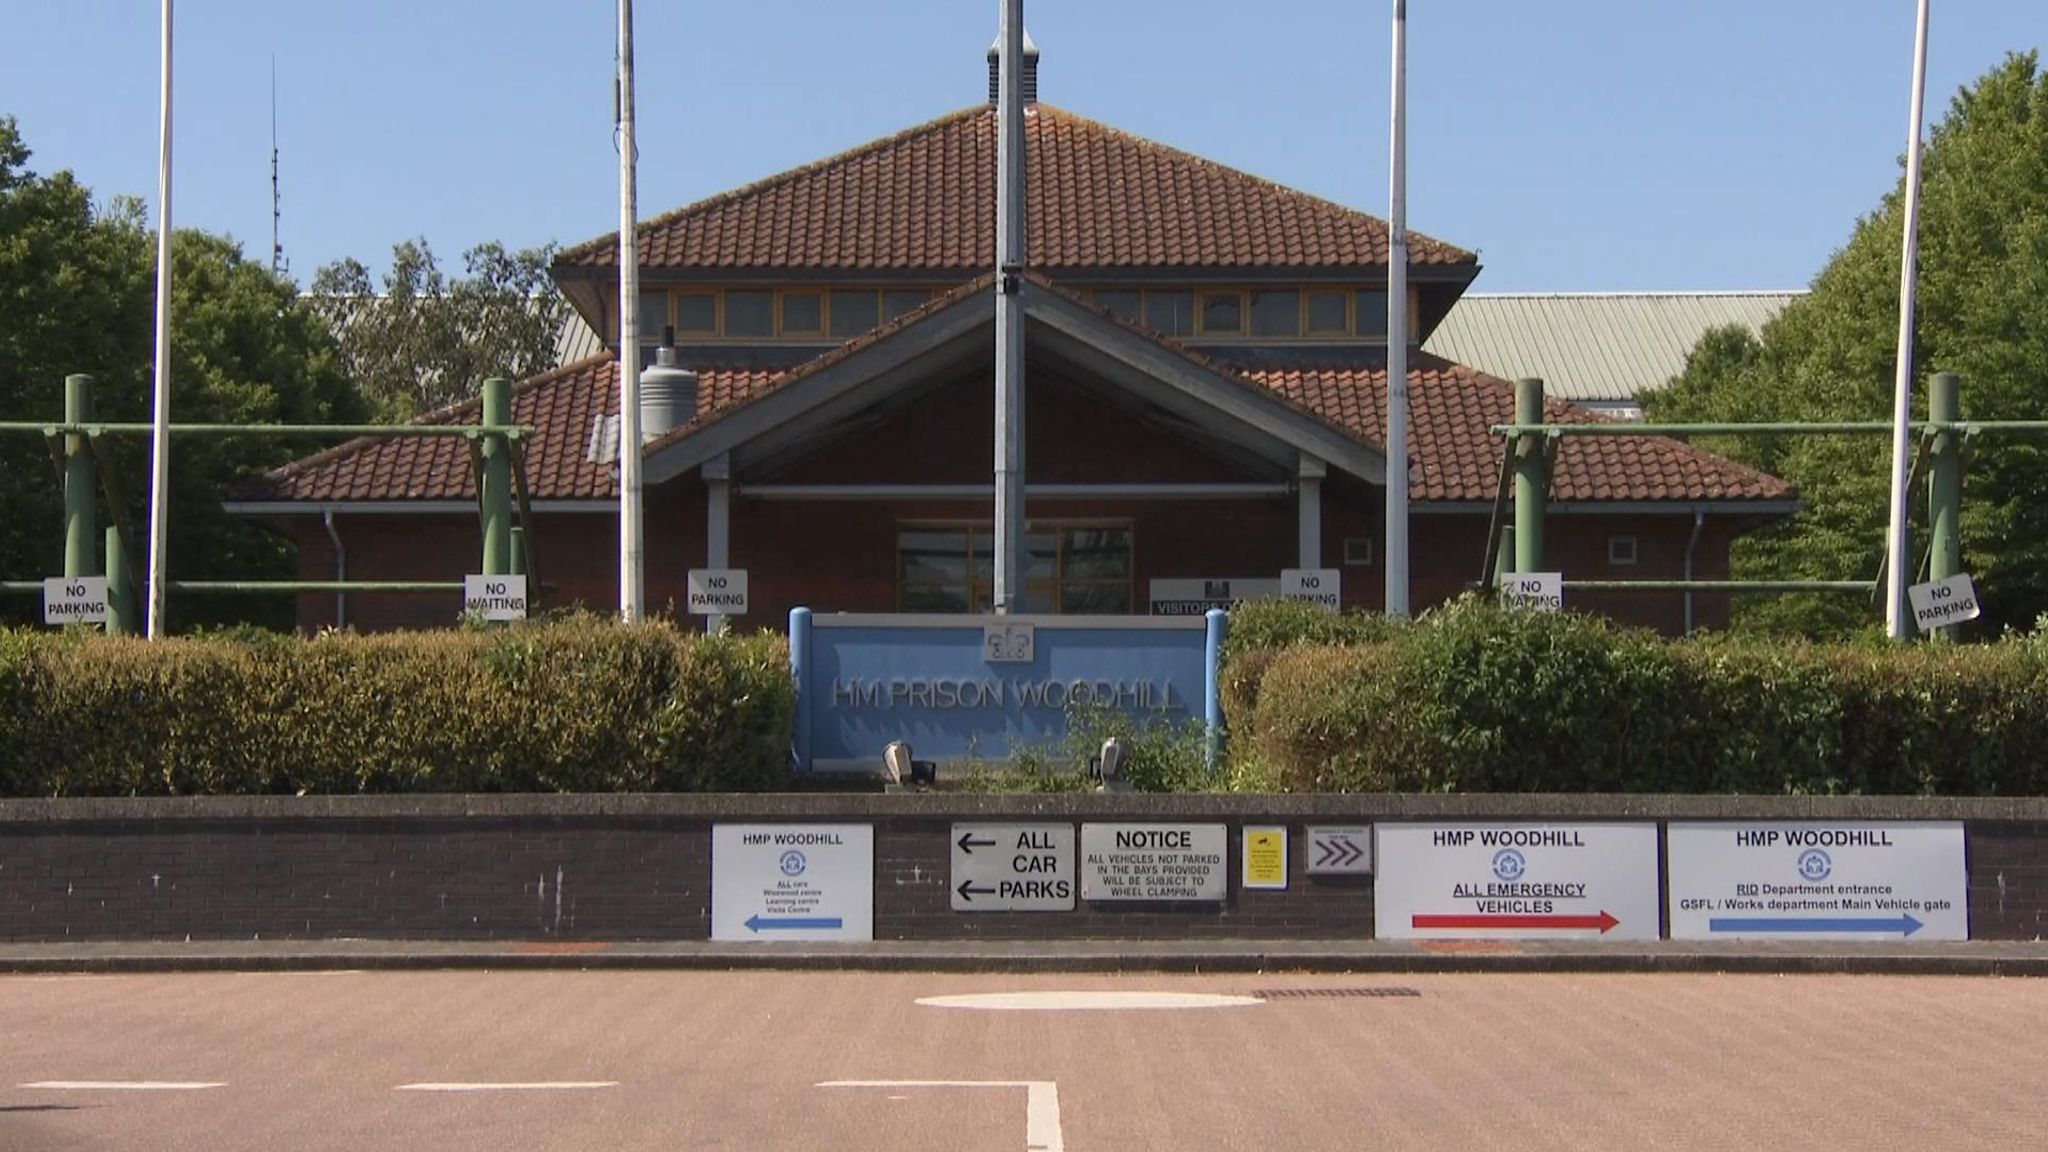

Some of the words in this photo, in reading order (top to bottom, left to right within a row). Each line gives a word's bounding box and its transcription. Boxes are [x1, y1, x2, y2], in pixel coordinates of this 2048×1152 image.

[708, 577, 727, 588] NO
[1301, 577, 1320, 588] NO
[1521, 581, 1541, 592] NO
[66, 585, 86, 597] NO
[486, 583, 506, 595] NO
[1931, 586, 1951, 600] NO
[691, 593, 744, 605] PARKING
[48, 602, 105, 615] PARKING
[1919, 598, 1973, 621] PARKING
[832, 678, 879, 708] HM
[889, 678, 1004, 708] PRISON
[1014, 678, 1184, 709] WOODHILL
[743, 834, 771, 845] HMP
[774, 834, 843, 845] WOODHILL
[1016, 832, 1055, 849] ALL
[1116, 831, 1192, 848] NOTICE
[1433, 831, 1475, 847] HMP
[1480, 831, 1585, 847] WOODHILL
[1737, 831, 1779, 846] HMP
[1785, 831, 1893, 846] WOODHILL
[1012, 856, 1057, 873] CAR
[1088, 854, 1103, 864] ALL
[1109, 854, 1153, 864] VEHICLES
[1158, 854, 1178, 864] NOT
[1183, 854, 1220, 864] PARKED
[1098, 865, 1108, 875] IN
[1112, 865, 1130, 875] THE
[1135, 865, 1158, 875] BAYS
[1163, 865, 1210, 875] PROVIDED
[777, 881, 791, 889] ALL
[1103, 876, 1124, 886] WILL
[1129, 876, 1141, 886] BE
[1146, 876, 1187, 886] SUBJECT
[1192, 876, 1205, 886] TO
[1000, 881, 1070, 898] PARKS
[1111, 887, 1142, 897] WHEEL
[1147, 887, 1197, 897] CLAMPING
[1453, 883, 1482, 897] ALL
[1487, 883, 1586, 897] EMERGENCY
[1762, 884, 1834, 897] Department
[1838, 885, 1893, 895] entrance
[766, 898, 796, 906] Learning
[1477, 901, 1553, 913] VEHICLES
[1680, 900, 1714, 910] GSFL
[1725, 900, 1764, 910] Works
[1768, 900, 1839, 912] department
[1842, 900, 1872, 910] Main
[1875, 900, 1921, 910] Vehicle
[1924, 901, 1951, 912] gate
